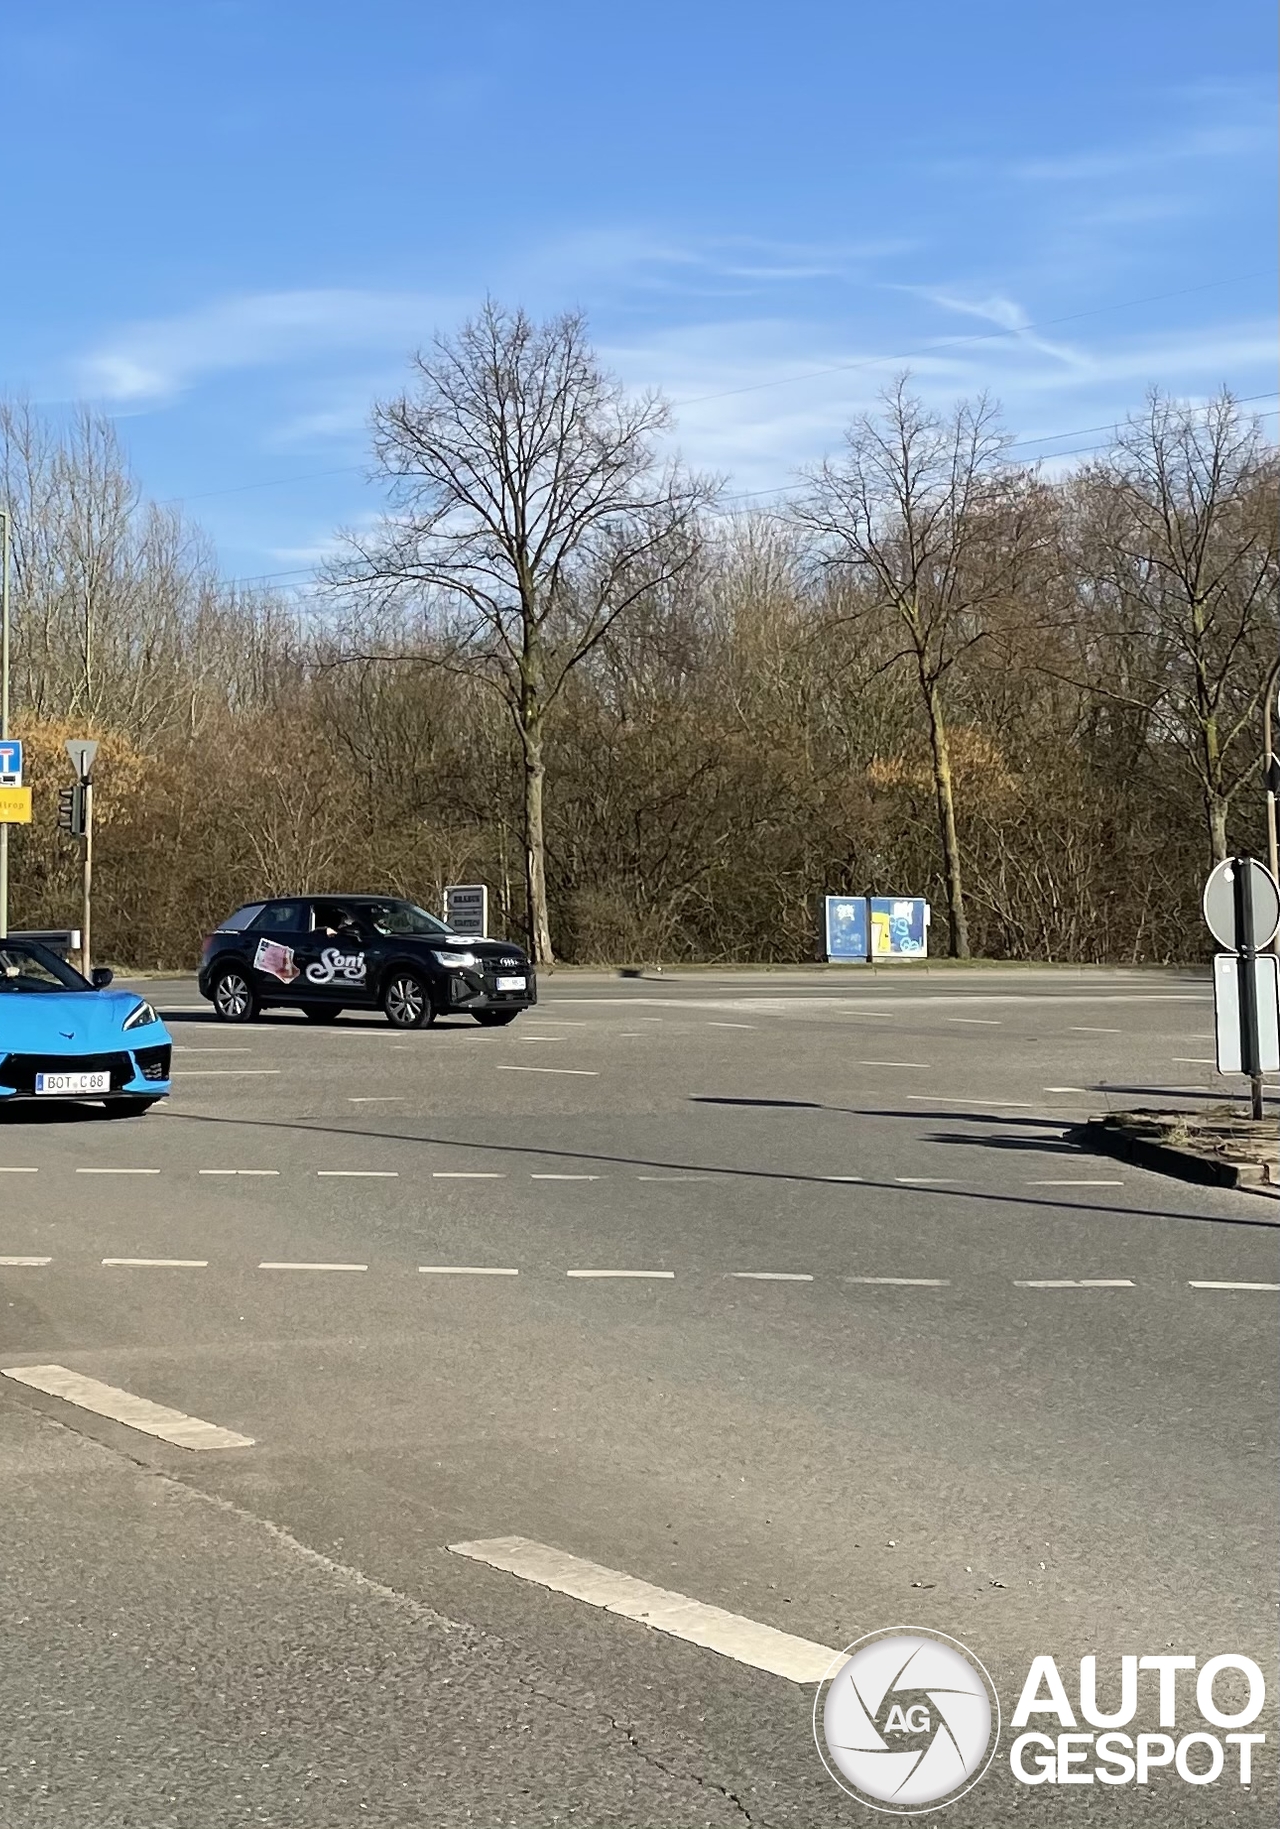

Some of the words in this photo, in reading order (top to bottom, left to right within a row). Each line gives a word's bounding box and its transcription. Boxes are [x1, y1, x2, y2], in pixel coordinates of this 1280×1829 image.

[305, 947, 367, 984] Soni
[47, 1076, 72, 1089] BOT
[80, 1075, 88, 1088] C
